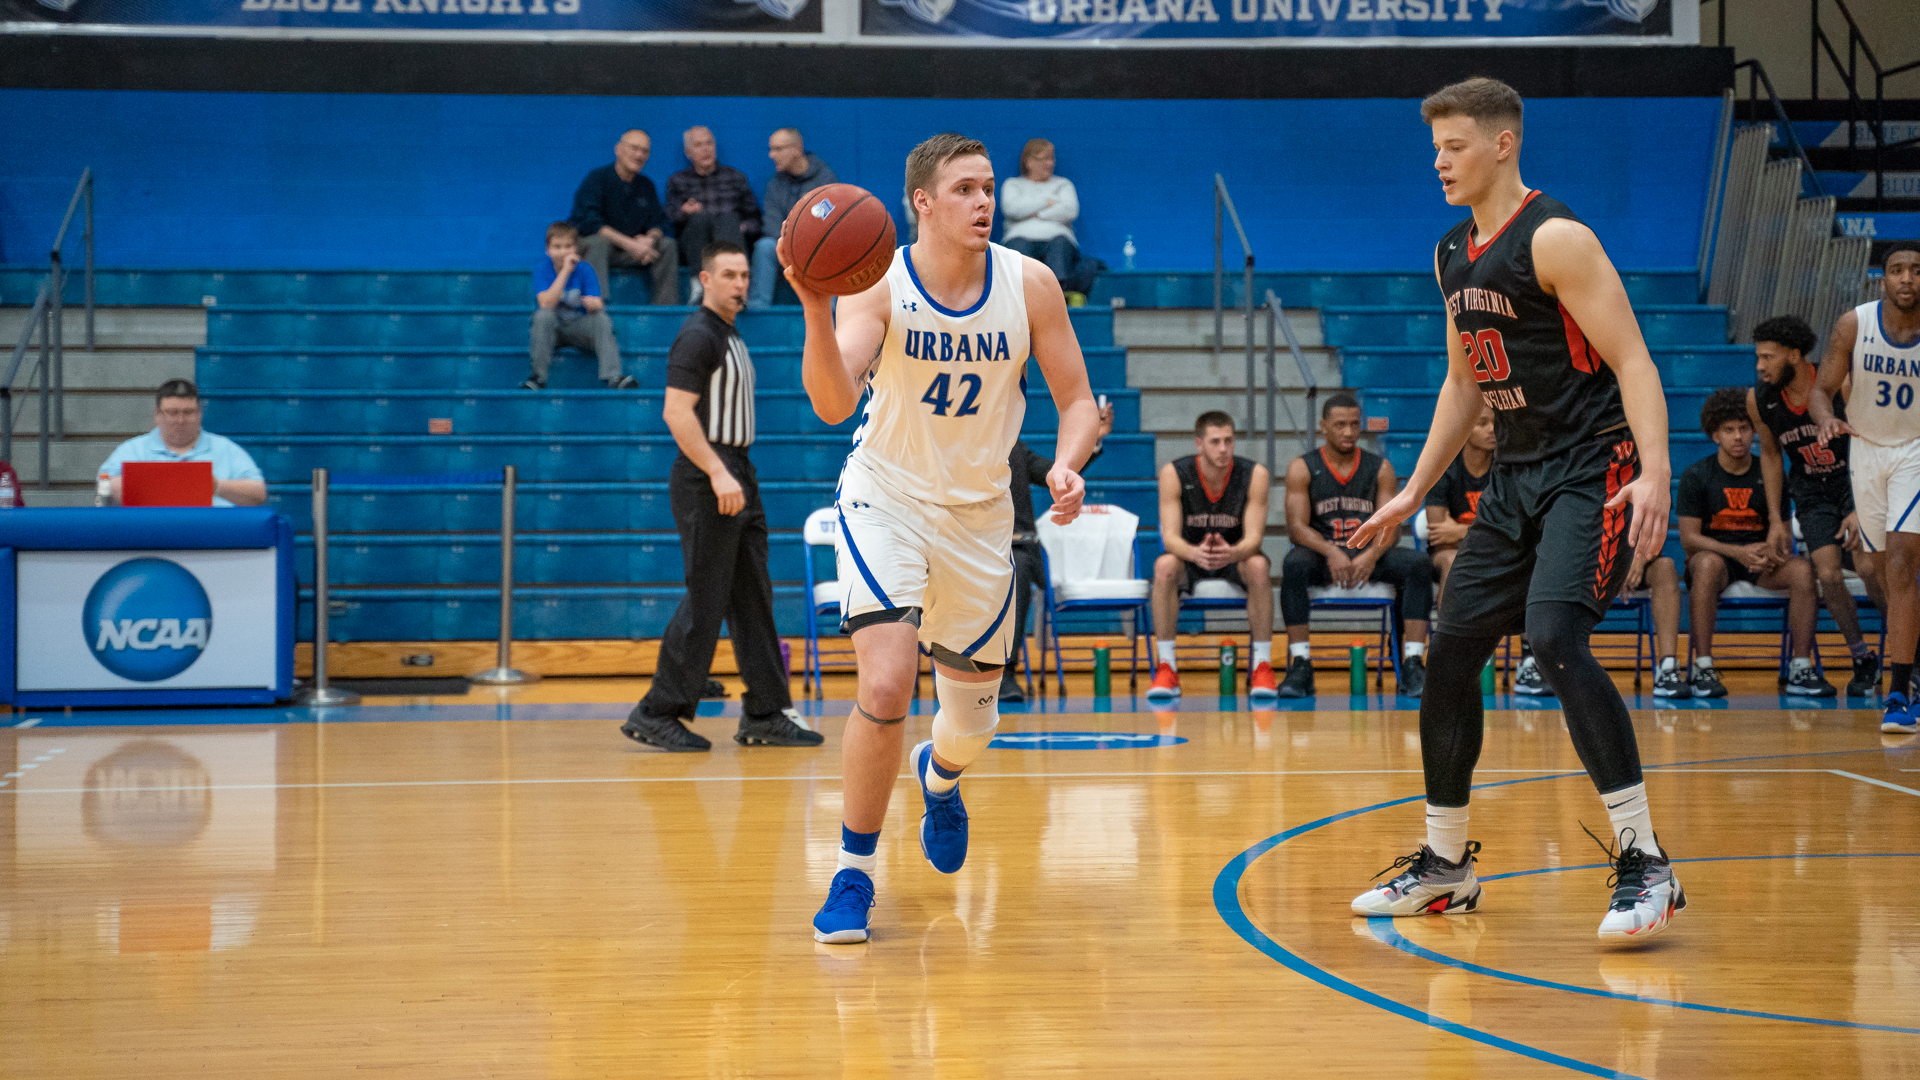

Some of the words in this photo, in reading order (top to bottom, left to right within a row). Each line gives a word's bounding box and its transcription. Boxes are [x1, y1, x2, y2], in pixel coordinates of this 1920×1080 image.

[1029, 0, 1220, 23] URBANA
[1231, 0, 1503, 22] UNIVERSITY
[1463, 287, 1519, 320] VIRGINIA
[904, 328, 1011, 362] URBANA
[1460, 327, 1511, 383] 20
[1863, 353, 1920, 378] URBAN
[920, 372, 982, 417] 42
[1875, 380, 1915, 410] 30
[1797, 441, 1836, 467] 15
[1316, 496, 1340, 515] WEST
[96, 618, 208, 651] NCAA
